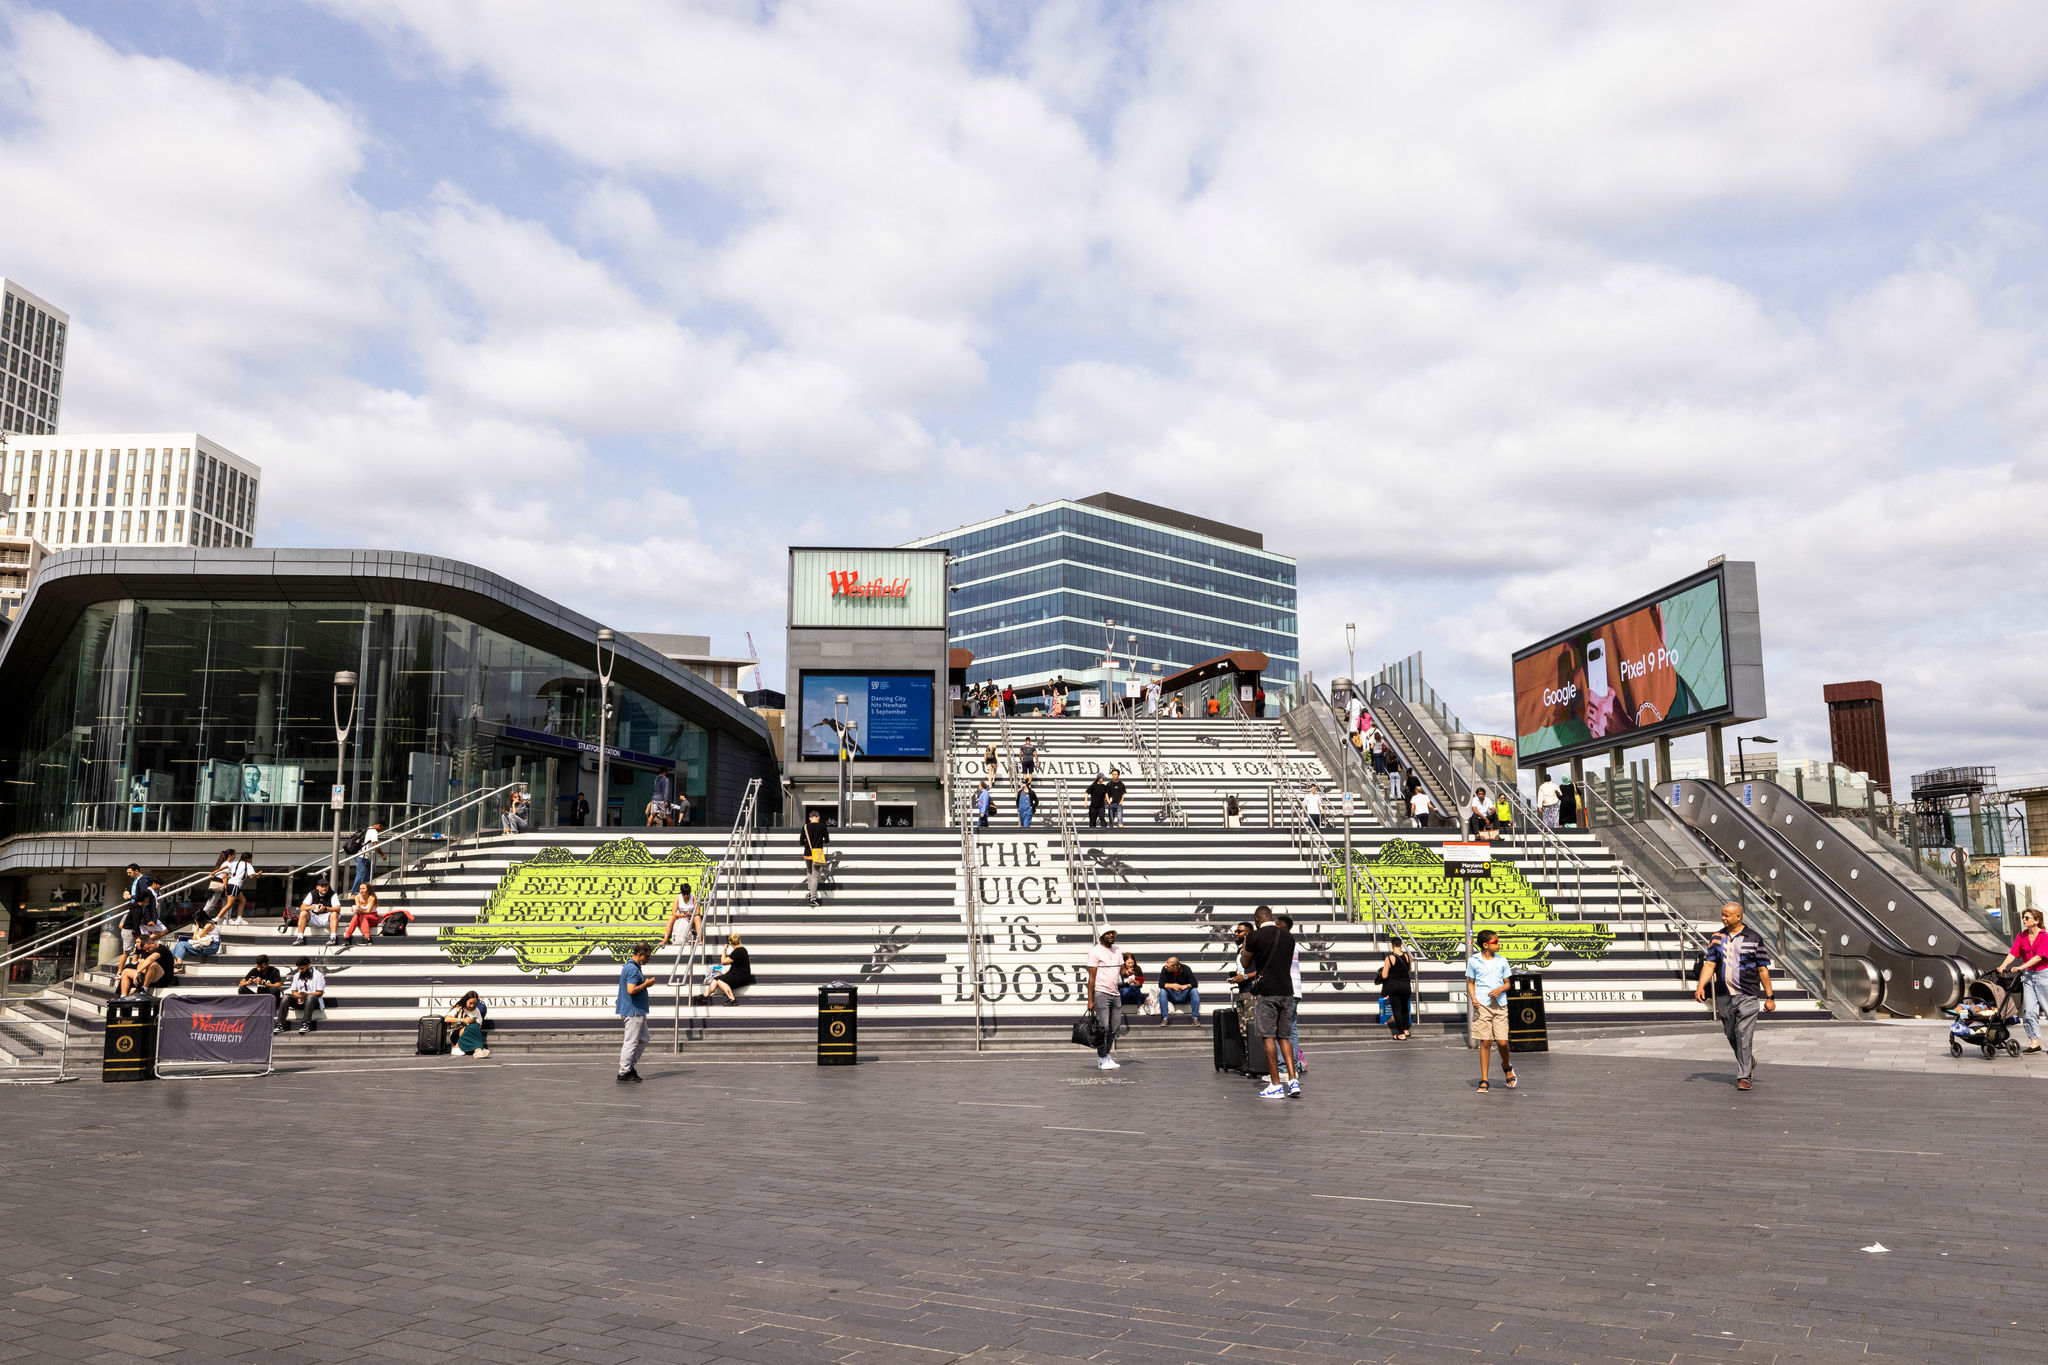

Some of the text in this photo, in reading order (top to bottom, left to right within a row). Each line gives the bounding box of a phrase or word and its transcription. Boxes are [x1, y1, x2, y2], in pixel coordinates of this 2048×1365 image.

[827, 570, 911, 598] Westfield
[1620, 646, 1679, 682] Pixel 9 Pro
[1543, 681, 1577, 707] Google
[578, 742, 621, 757] STRATFOR TATION
[1033, 761, 1100, 775] WAITED
[1109, 761, 1132, 775] AN
[1232, 761, 1273, 775] FOR
[976, 842, 1041, 867] THE
[81, 882, 106, 903] PRE
[520, 876, 689, 899] BEETLEJUICE
[978, 876, 1062, 905] UICE
[1000, 915, 1042, 952] IS
[531, 946, 577, 954] 2024 A.D.
[954, 965, 1089, 1002] LOOSE
[427, 997, 442, 1007] IN
[449, 997, 516, 1007] CMAS
[522, 997, 609, 1007] SEPTEMBER
[1545, 993, 1626, 1001] SEPTEMBER
[192, 1013, 247, 1033] Westfield
[189, 1032, 242, 1043] STRATFORD CITY
